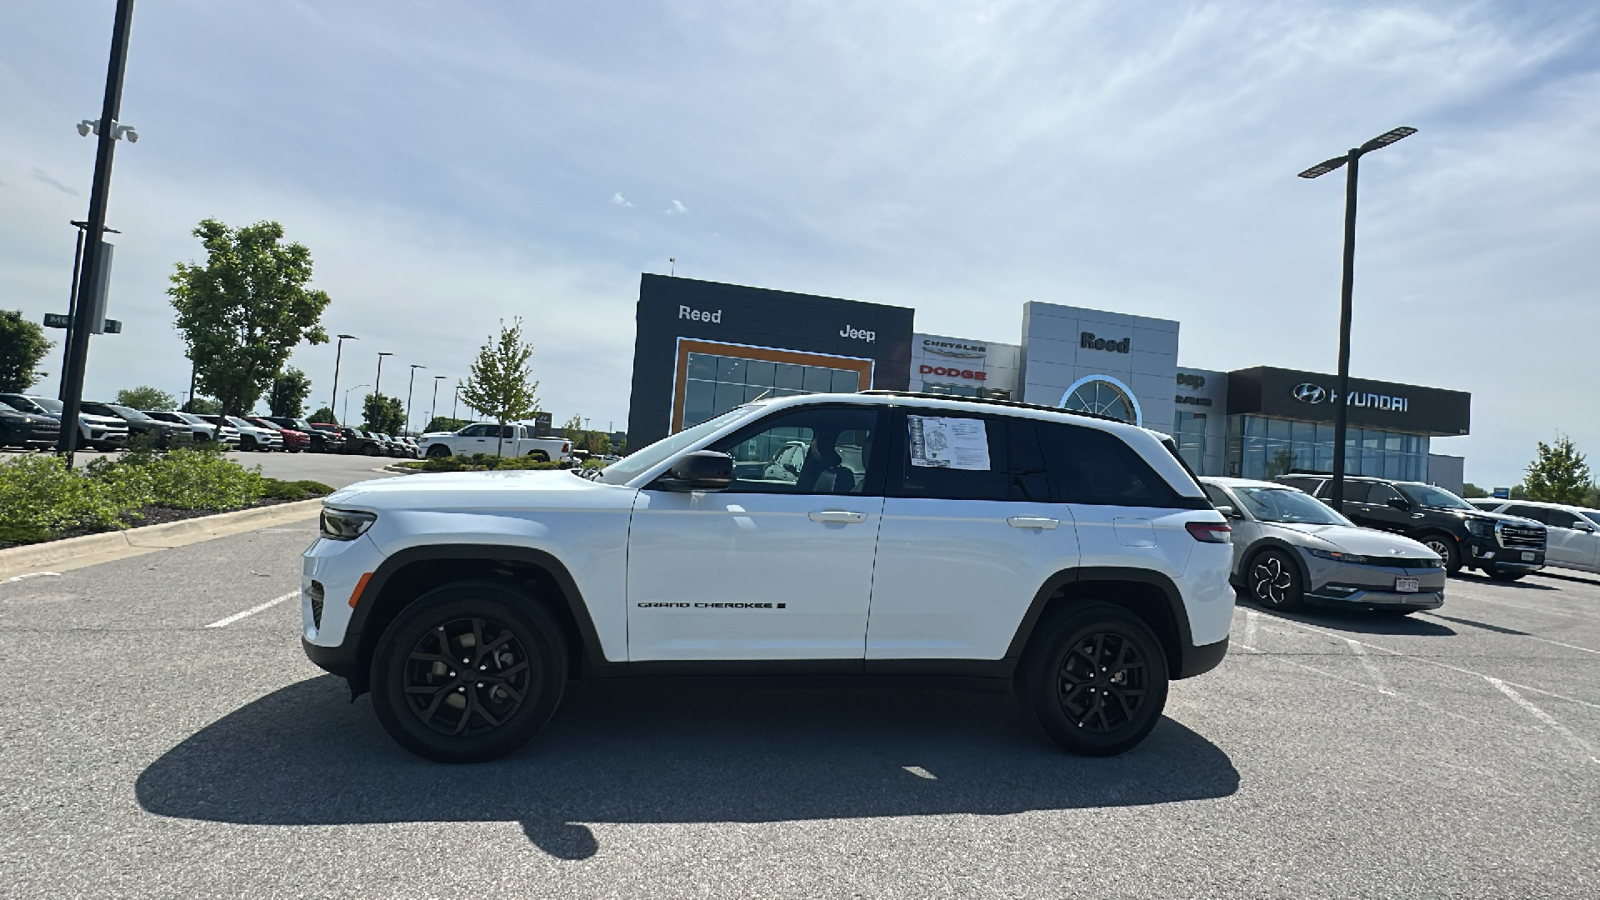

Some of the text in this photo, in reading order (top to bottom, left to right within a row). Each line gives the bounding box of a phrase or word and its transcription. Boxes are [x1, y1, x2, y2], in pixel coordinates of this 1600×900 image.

[678, 304, 722, 324] Reed
[839, 324, 876, 343] Jeep
[1080, 331, 1130, 353] Reed
[922, 339, 987, 352] CHRYSLER
[919, 364, 987, 381] DODGE
[1177, 373, 1205, 390] eep
[1330, 388, 1408, 412] HYUNDAI
